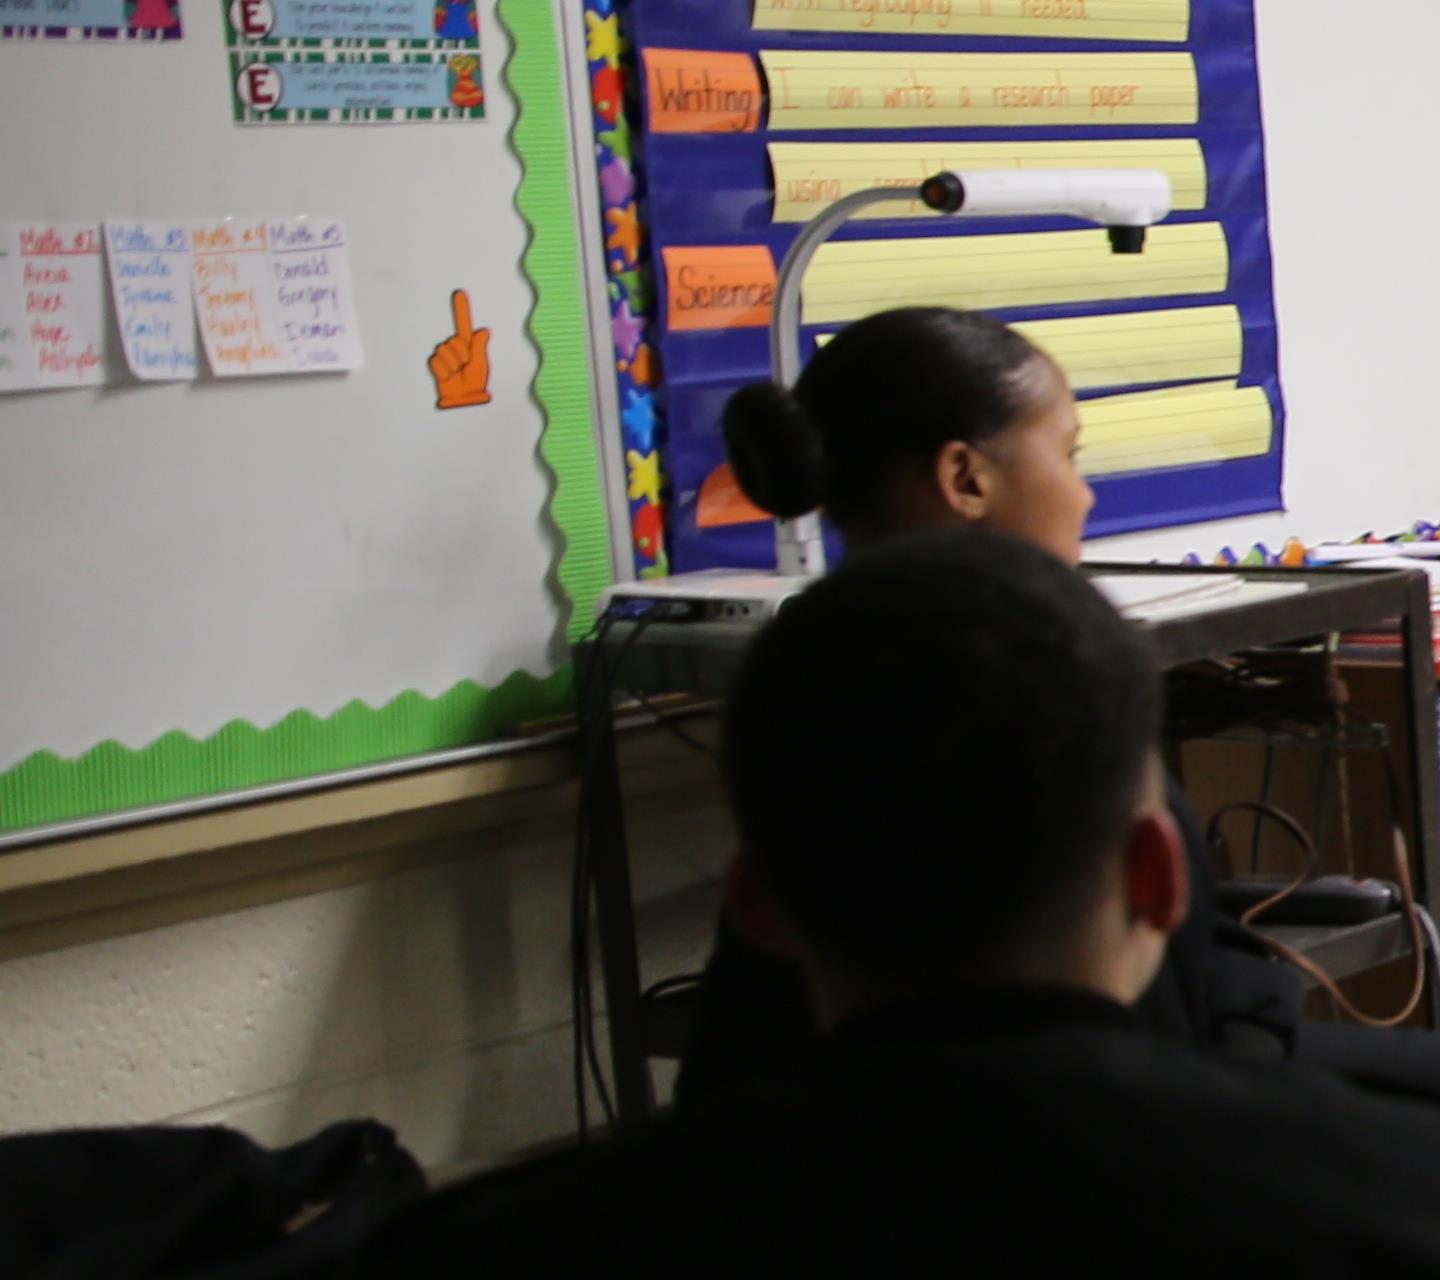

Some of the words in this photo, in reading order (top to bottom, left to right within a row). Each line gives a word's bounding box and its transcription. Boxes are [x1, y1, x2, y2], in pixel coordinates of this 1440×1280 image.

[247, 68, 273, 104] E
[656, 63, 751, 131] Writing
[771, 68, 799, 110] I
[827, 86, 862, 109] can
[884, 69, 935, 109] write
[960, 86, 971, 108] a
[993, 69, 1070, 109] research
[1089, 85, 1140, 118] paper
[676, 265, 773, 310] Science
